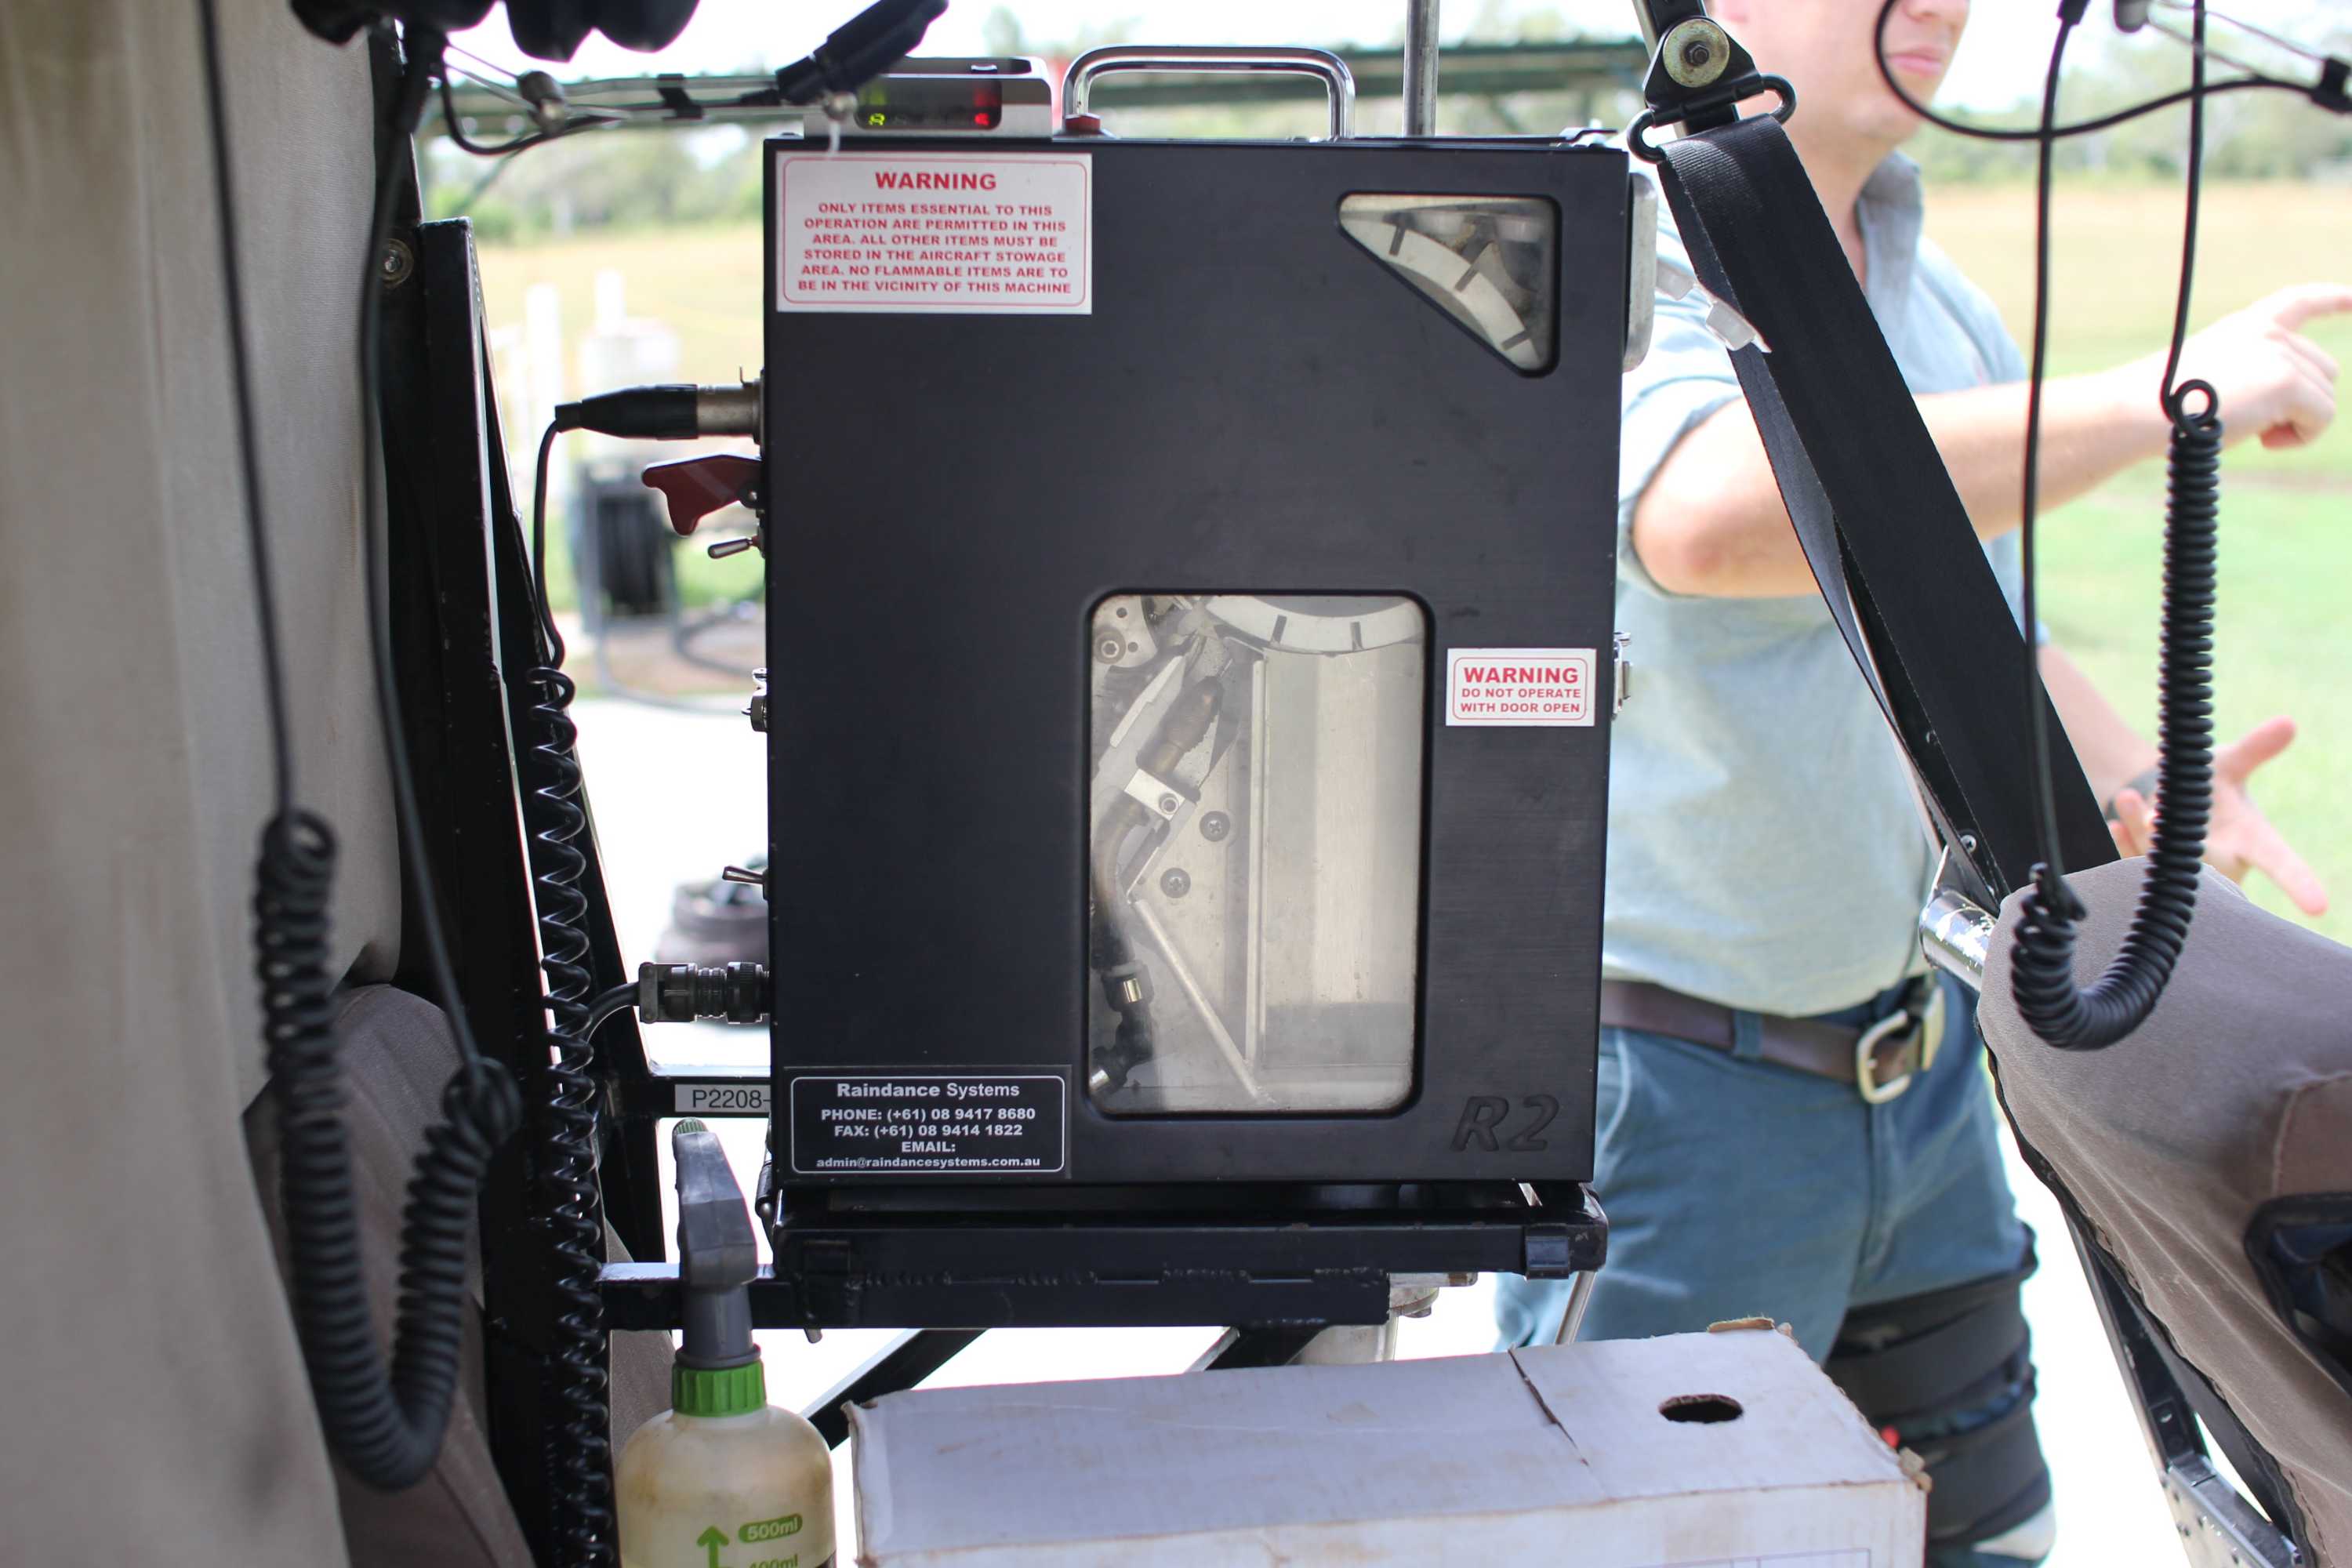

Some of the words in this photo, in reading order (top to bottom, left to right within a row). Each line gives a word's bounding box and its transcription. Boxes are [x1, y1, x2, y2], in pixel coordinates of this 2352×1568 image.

[875, 172, 997, 191] WARNING
[818, 203, 856, 215] ONLY
[862, 203, 906, 215] ITEMS
[911, 204, 990, 216] ESSENTIAL
[996, 205, 1014, 216] TO
[1020, 205, 1053, 216] THIS
[804, 218, 887, 230] OPERATION
[892, 220, 920, 230] ARE
[925, 220, 1007, 231] PERMITTED
[1012, 221, 1028, 231] IN
[1033, 221, 1066, 232] THIS
[812, 234, 855, 245] AREA.
[861, 235, 887, 245] ALL
[891, 235, 940, 246] OTHER
[945, 236, 989, 246] ITEMS
[993, 236, 1035, 247] MUST
[1040, 237, 1058, 247] BE
[804, 250, 862, 260] STORED
[866, 250, 882, 261] IN
[887, 250, 914, 261] THE
[920, 251, 992, 262] AIRCRAFT
[996, 252, 1066, 263] STOWAGE
[800, 265, 844, 276] AREA.
[849, 266, 869, 276] NO
[874, 266, 963, 277] FLAMMABLE
[967, 267, 1012, 278] ITEMS
[1016, 267, 1044, 278] ARE
[1049, 268, 1068, 278] TO
[798, 281, 817, 291] BE
[822, 281, 837, 292] IN
[843, 281, 869, 292] THE
[875, 281, 938, 292] VICINITY
[943, 282, 962, 292] OF
[967, 282, 1000, 293] THIS
[1005, 283, 1072, 294] MACHINE
[1464, 667, 1578, 684] WARNING
[1461, 688, 1480, 698] DO
[1486, 688, 1513, 698] NOT
[1518, 688, 1581, 698] OPERATE
[1461, 703, 1495, 713] WITH
[1501, 703, 1538, 713] DOOR
[1543, 703, 1580, 713] OPEN
[837, 1083, 940, 1097] Raindance
[947, 1083, 1019, 1100] Systems
[822, 1109, 881, 1120] PHONE:
[887, 1109, 926, 1123] (+61)
[931, 1109, 949, 1120] 08
[955, 1109, 993, 1120] 9417
[998, 1109, 1035, 1120] 8680
[1452, 1095, 1559, 1152] R2
[835, 1126, 869, 1136] FAX:
[874, 1125, 913, 1138] (+61)
[919, 1125, 937, 1136] 08
[942, 1125, 980, 1135] 9414
[985, 1124, 1022, 1135] 1822
[902, 1142, 955, 1152] EMAIL:
[816, 1157, 1040, 1169] admin@raindancesystems.com.au
[747, 1518, 799, 1540] 500ml
